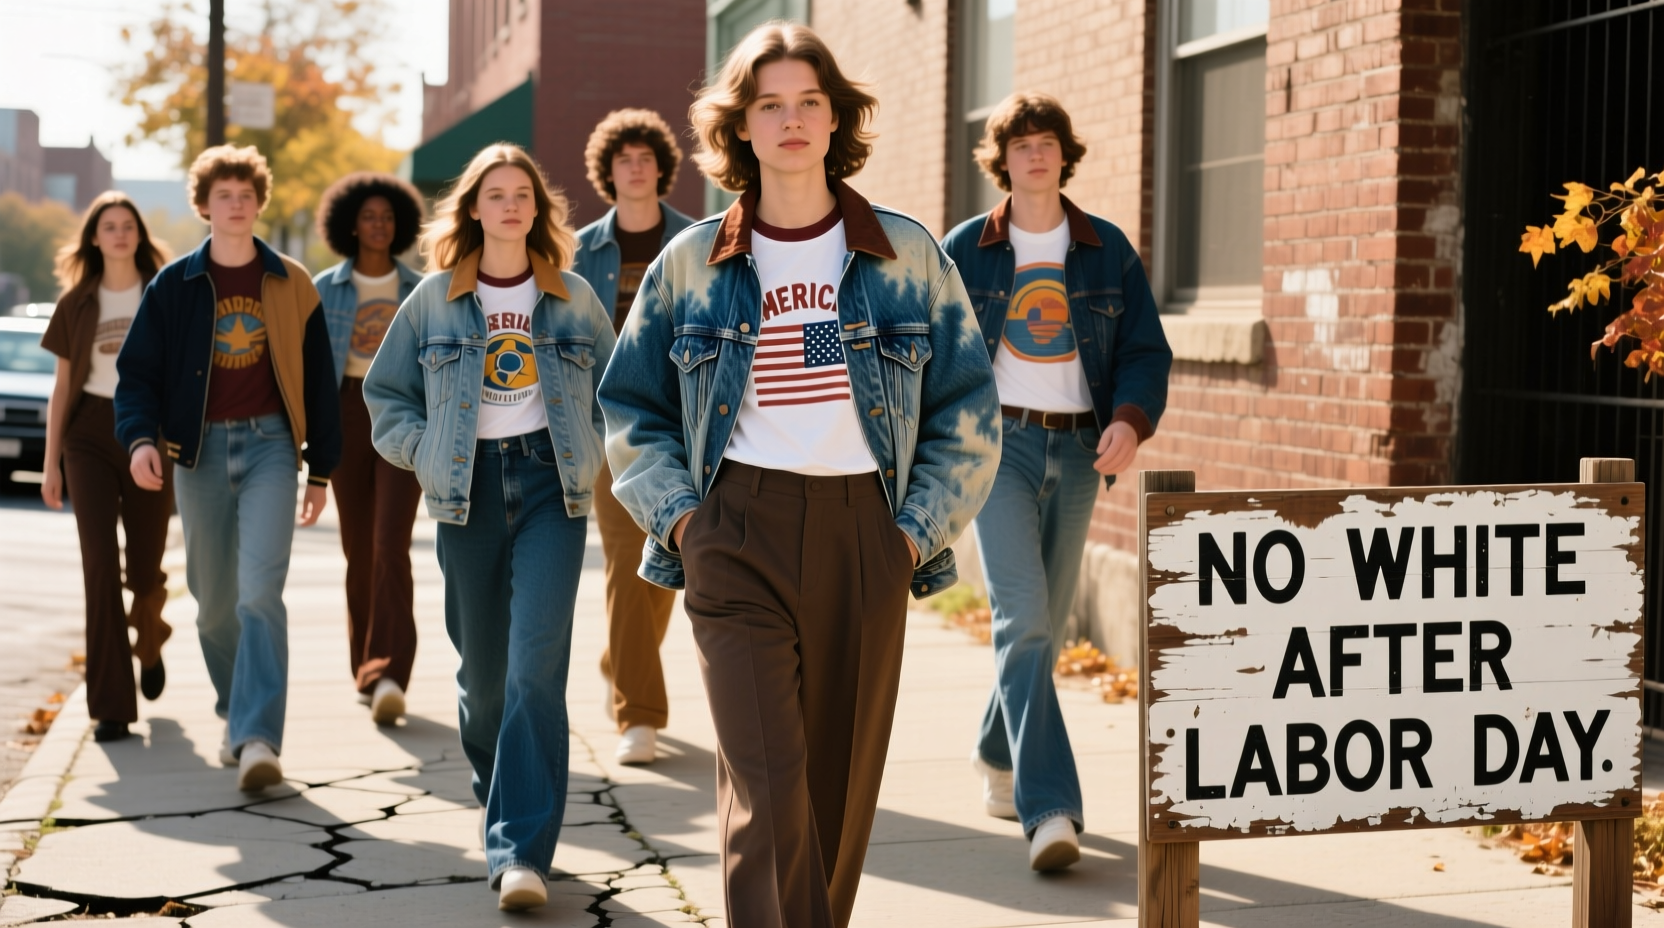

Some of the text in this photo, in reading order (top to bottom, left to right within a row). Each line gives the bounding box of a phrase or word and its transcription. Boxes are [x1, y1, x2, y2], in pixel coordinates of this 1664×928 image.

[761, 282, 838, 322] MERIC
[1198, 522, 1586, 606] NO WHITE
[1272, 620, 1513, 699] AFTER
[1185, 709, 1613, 801] LABOR DAY.
